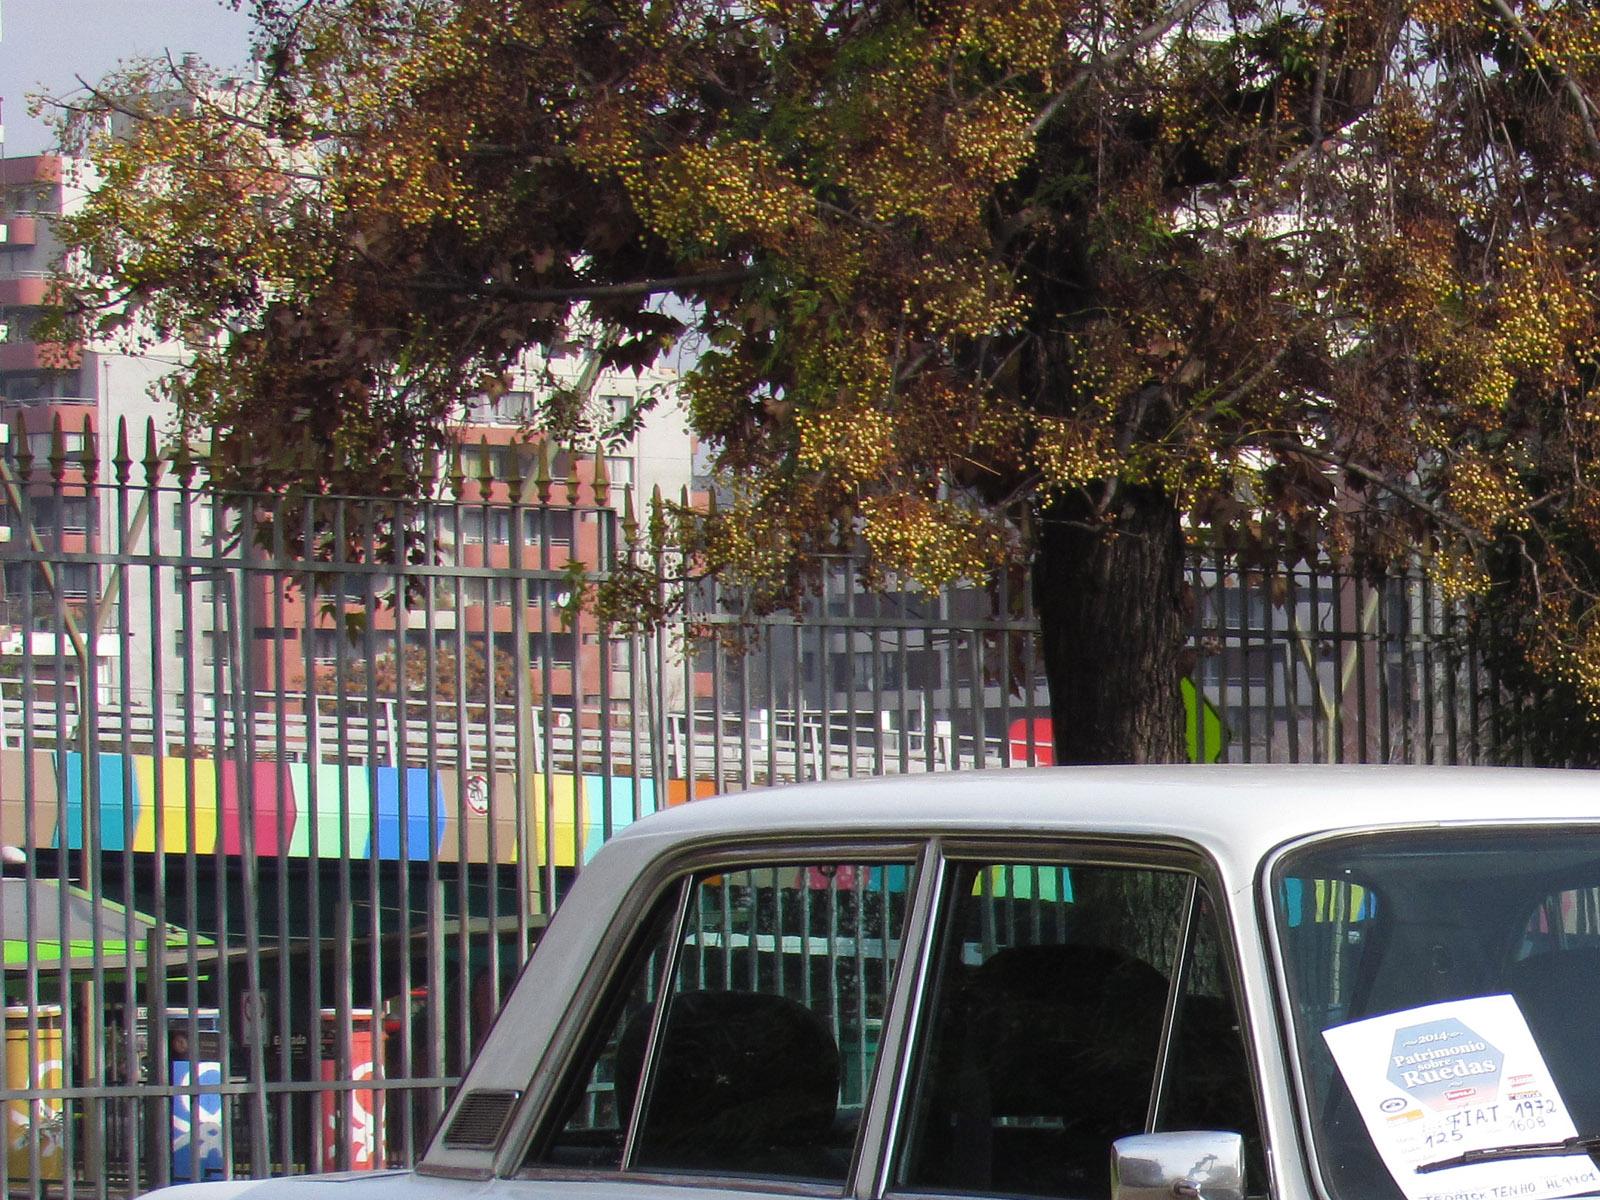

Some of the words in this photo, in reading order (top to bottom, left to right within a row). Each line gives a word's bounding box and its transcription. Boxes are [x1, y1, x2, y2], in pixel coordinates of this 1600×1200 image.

[1418, 1031, 1448, 1045] 2014
[1392, 1040, 1487, 1067] Patrimonio
[1417, 1058, 1452, 1072] sobre
[1400, 1058, 1498, 1089] Ruedas
[1446, 1105, 1500, 1131] FIAT
[1514, 1099, 1557, 1119] 1972
[1425, 1129, 1464, 1149] 125
[1508, 1116, 1546, 1132] 1608
[1492, 1182, 1536, 1199] TENHO
